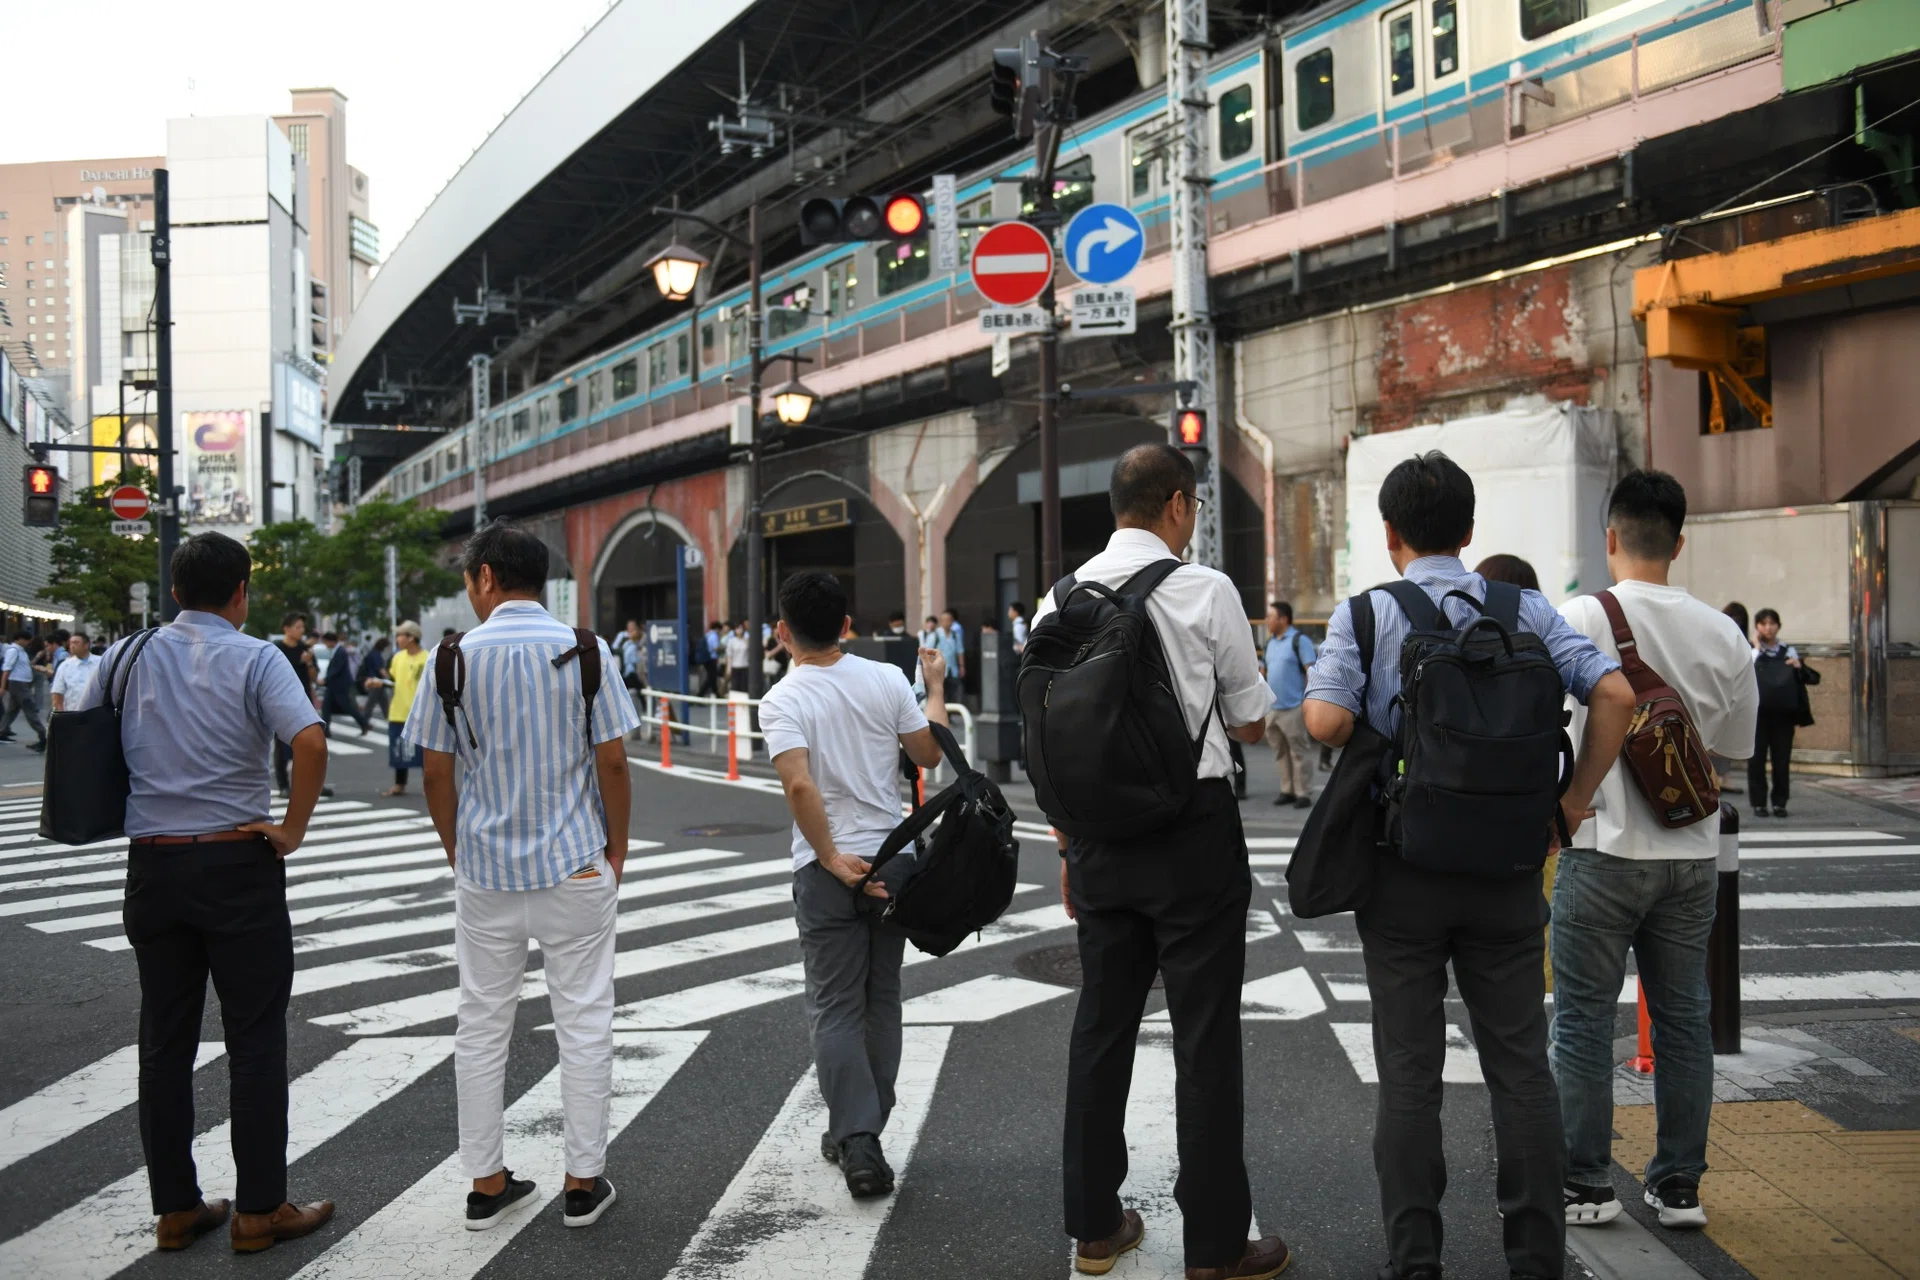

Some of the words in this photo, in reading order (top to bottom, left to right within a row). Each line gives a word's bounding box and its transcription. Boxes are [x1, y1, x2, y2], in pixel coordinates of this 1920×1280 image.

[1076, 306, 1130, 319] 一方通行
[983, 313, 1041, 328] 自転車を除く
